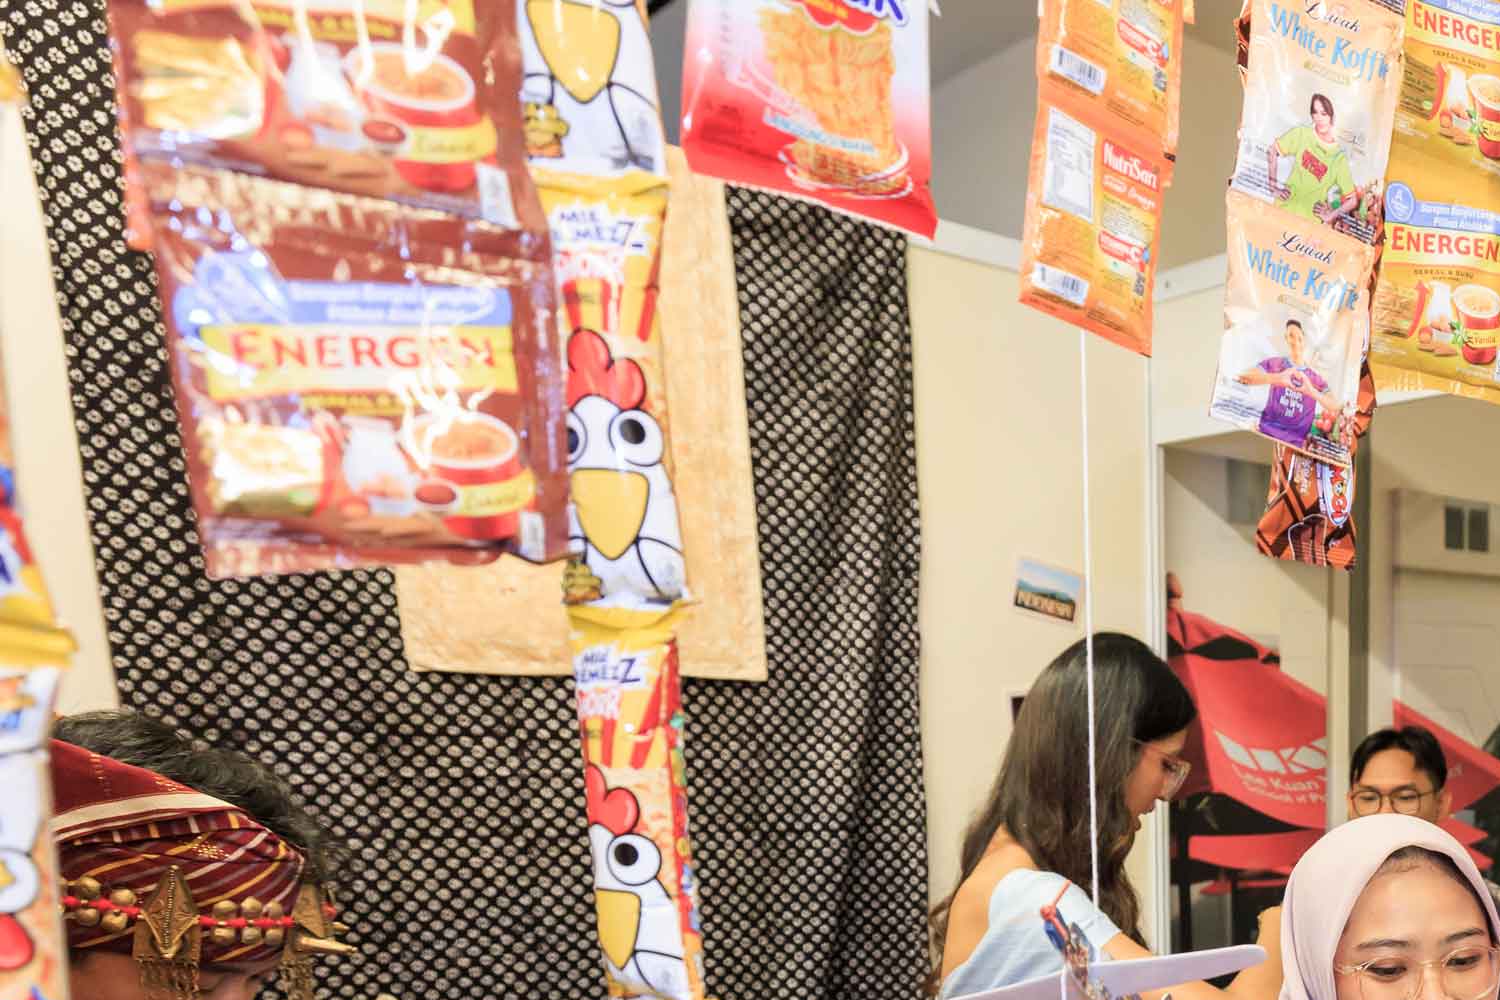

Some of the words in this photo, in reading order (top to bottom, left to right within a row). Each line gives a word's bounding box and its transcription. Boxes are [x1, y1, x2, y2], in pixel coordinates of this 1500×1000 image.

[1270, 3, 1327, 57] White
[1247, 241, 1300, 290] White
[1392, 226, 1500, 262] ENERGEN
